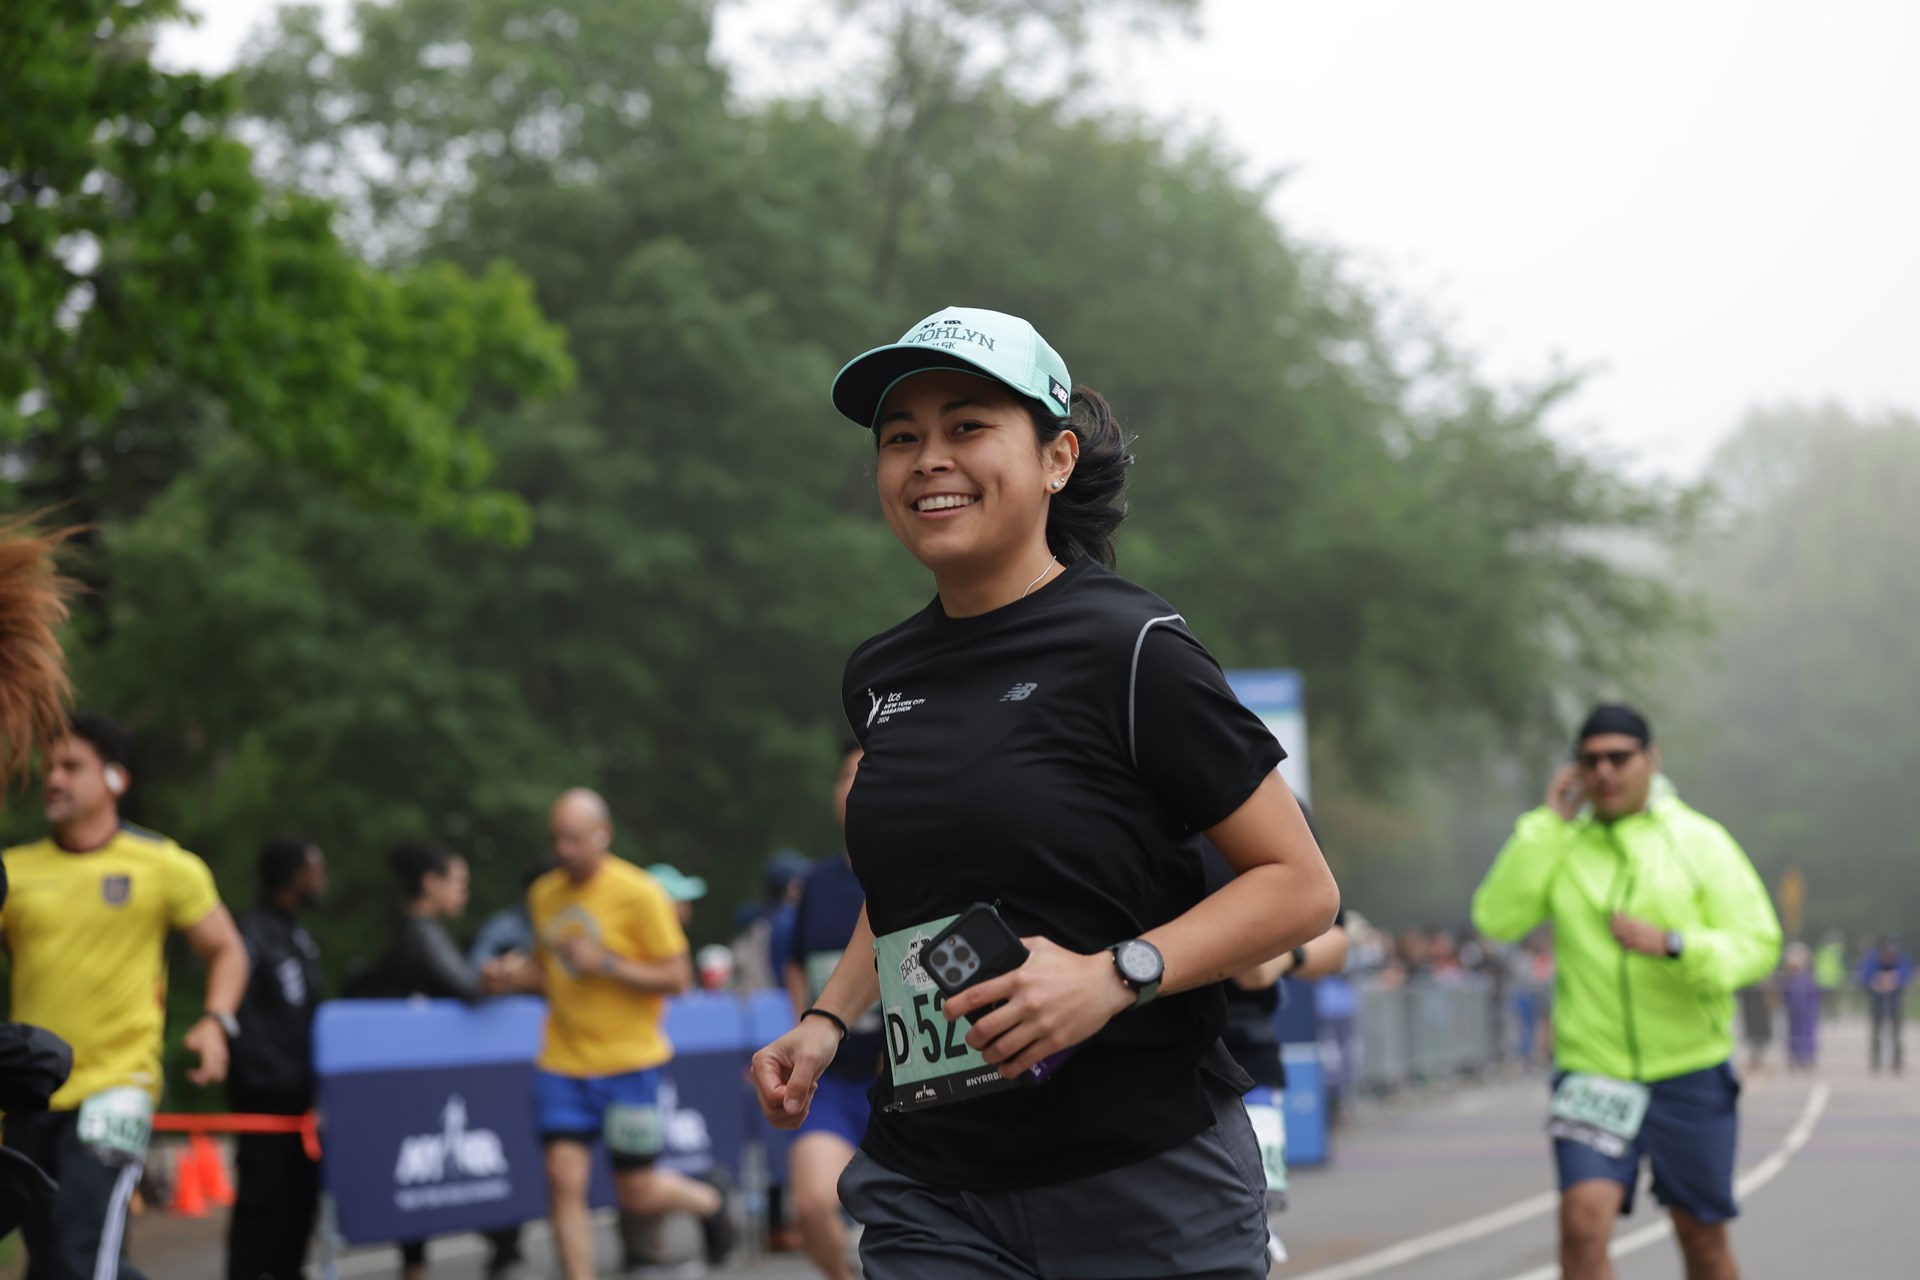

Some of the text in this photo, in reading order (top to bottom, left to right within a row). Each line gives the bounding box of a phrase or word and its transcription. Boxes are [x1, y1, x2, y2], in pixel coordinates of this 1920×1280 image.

[907, 327, 996, 352] OOKLYN
[880, 705, 912, 716] MARATHON
[883, 702, 899, 710] NEW
[912, 698, 926, 706] CITY
[900, 952, 922, 982] BROO
[888, 990, 969, 1066] D 52
[965, 1071, 1005, 1087] #NYRRB
